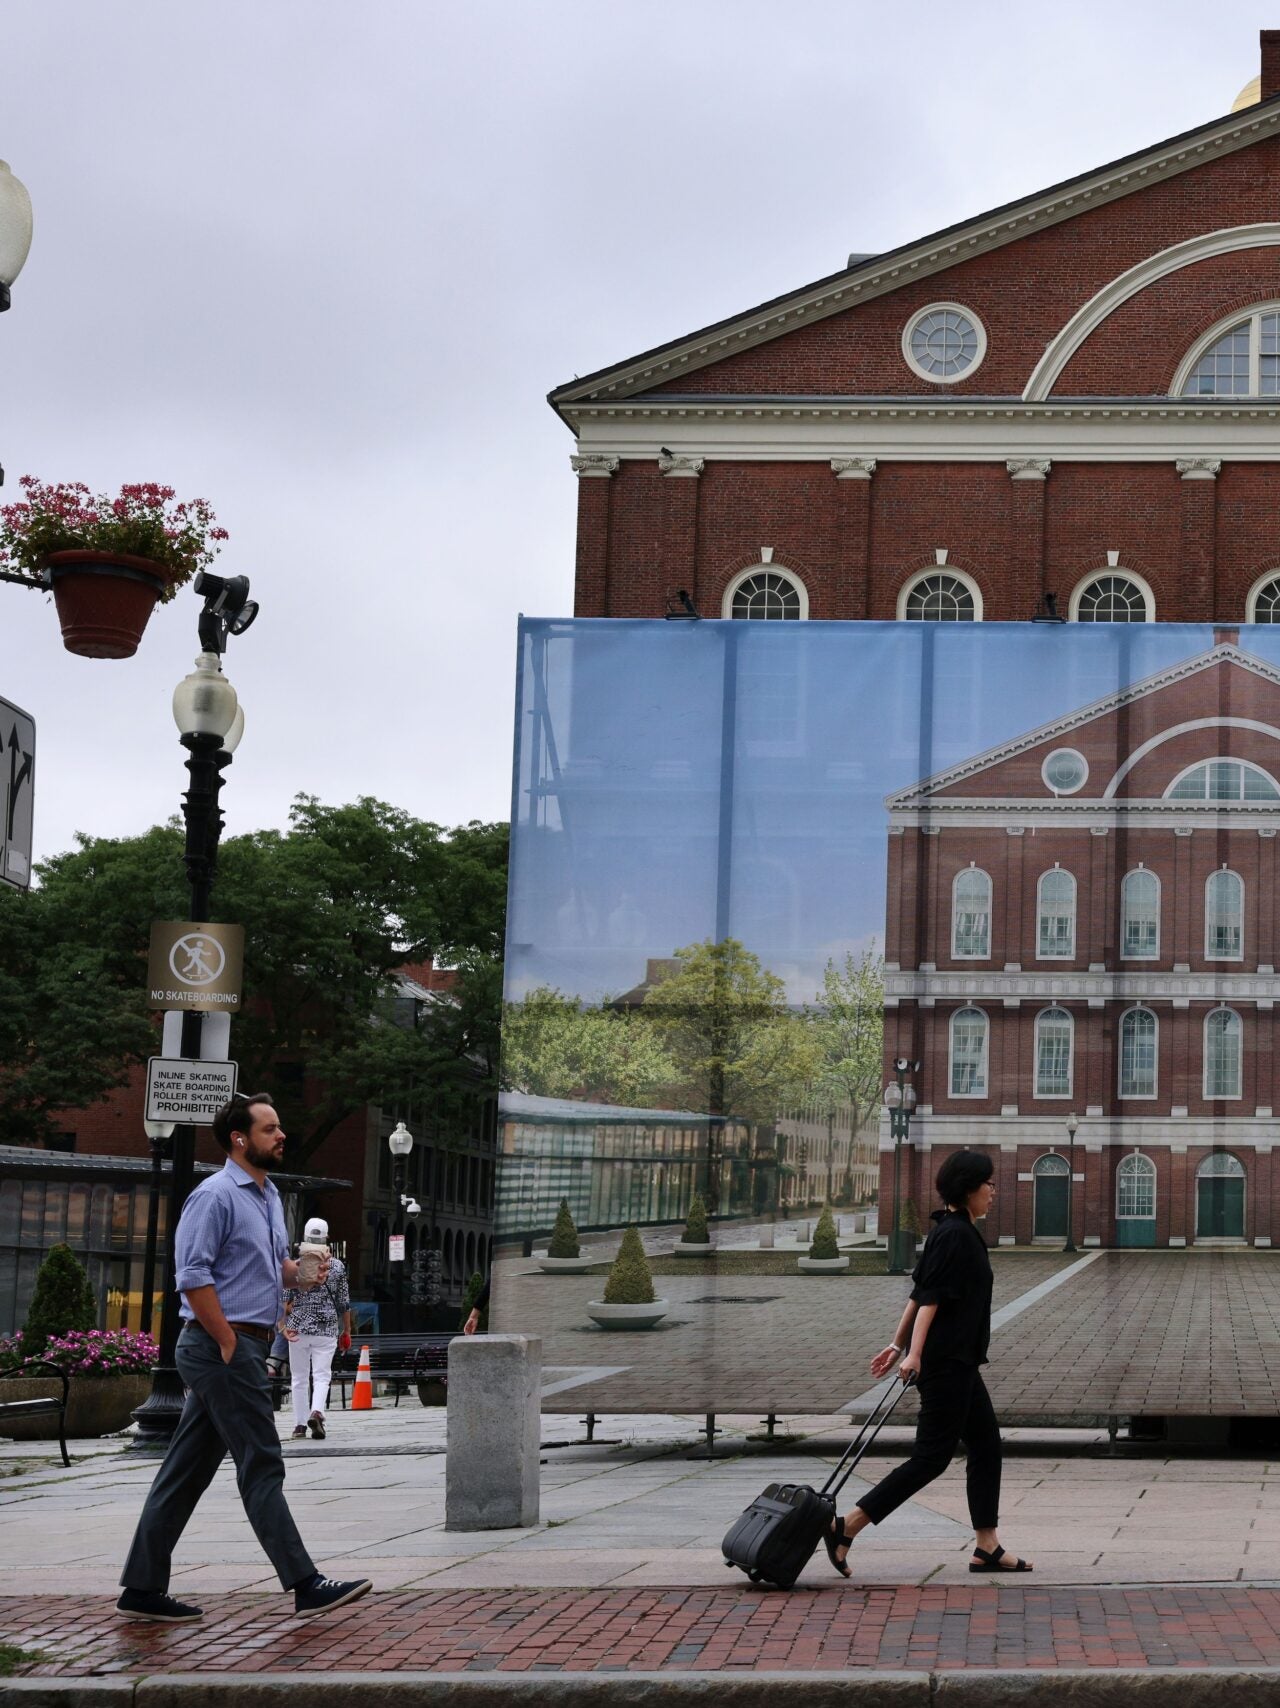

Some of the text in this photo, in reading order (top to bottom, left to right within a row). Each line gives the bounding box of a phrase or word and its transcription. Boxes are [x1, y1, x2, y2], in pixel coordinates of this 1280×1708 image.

[151, 990, 238, 1003] NO SKATEBOARDING
[158, 1072, 227, 1082] INLINE SKATING
[153, 1081, 230, 1092] SKATE BOARDING
[153, 1092, 228, 1102] ROLLER SKATING
[157, 1102, 223, 1113] PROHIBITED
